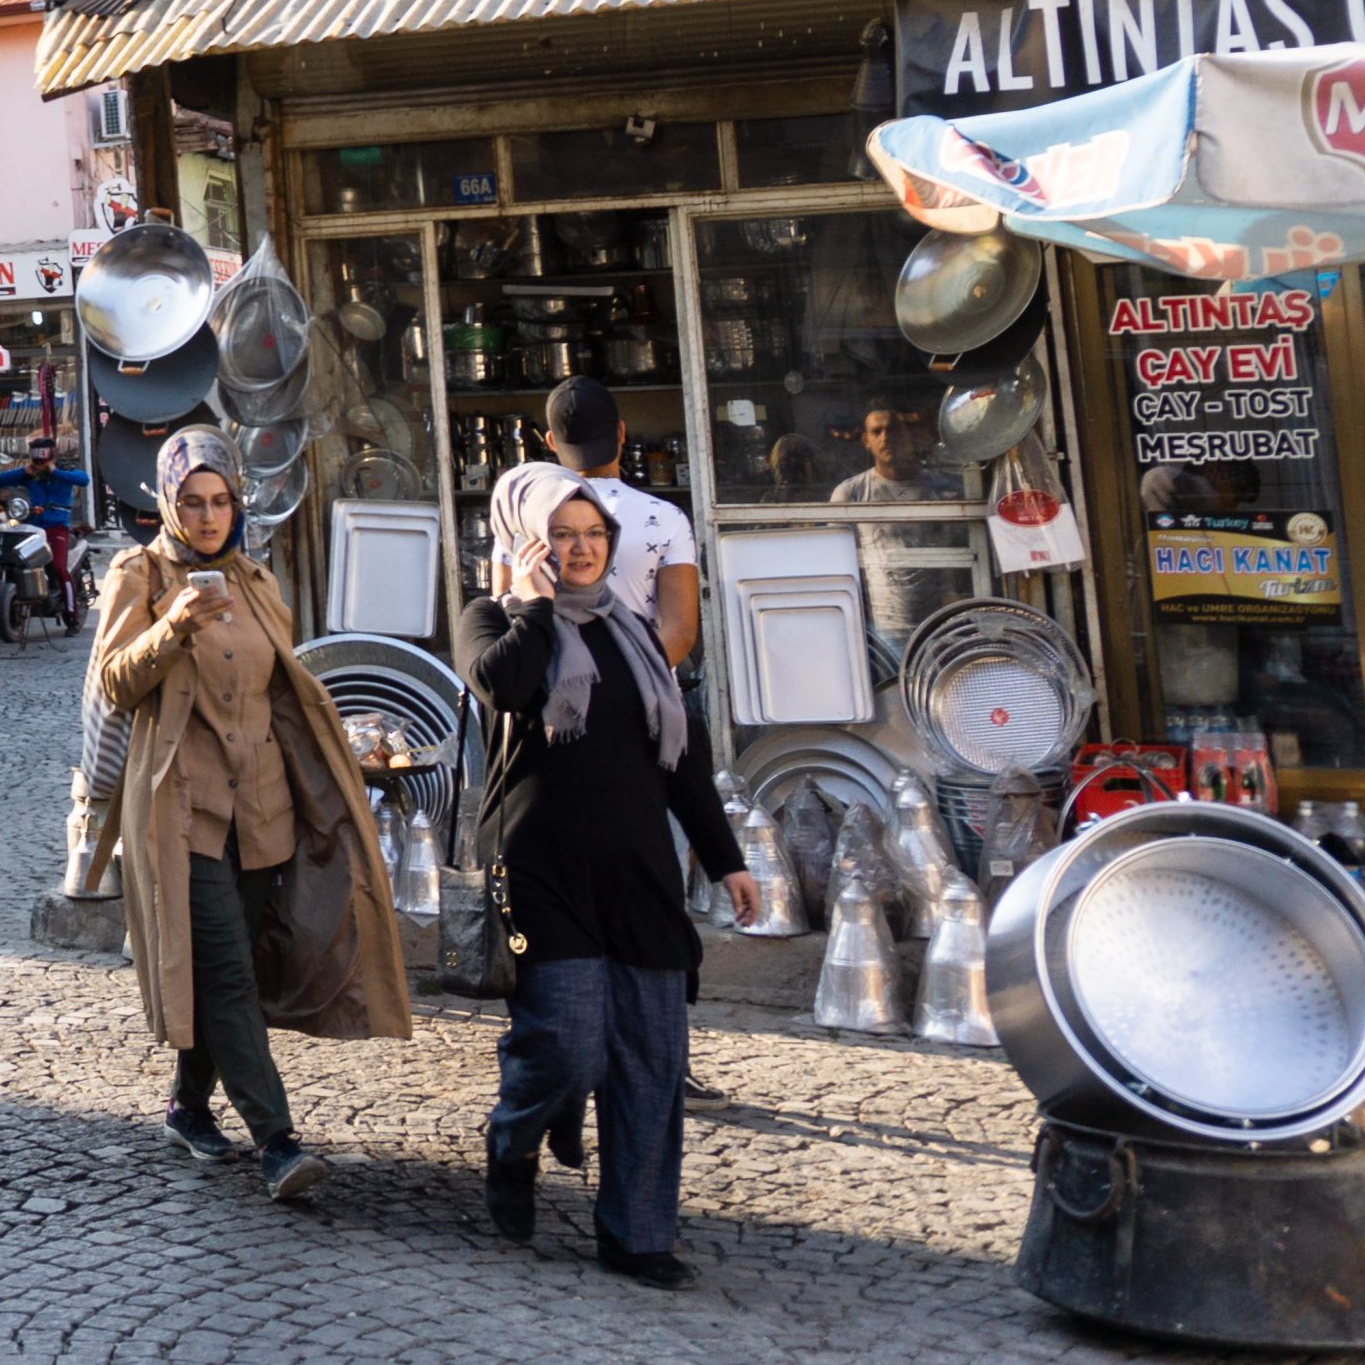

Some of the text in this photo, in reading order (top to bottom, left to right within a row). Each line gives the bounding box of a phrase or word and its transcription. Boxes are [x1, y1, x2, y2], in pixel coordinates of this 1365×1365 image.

[461, 177, 491, 195] 66A
[1109, 291, 1315, 334] ALTINTAŞ
[1137, 334, 1298, 388] ÇAY EVİ
[1134, 391, 1200, 425] ÇAY
[1225, 387, 1312, 419] TOST
[1138, 428, 1318, 465] MEŞRUBAT
[1155, 546, 1332, 575] HACI KANAT
[1259, 577, 1337, 598] Turizm
[1161, 604, 1184, 613] HAC
